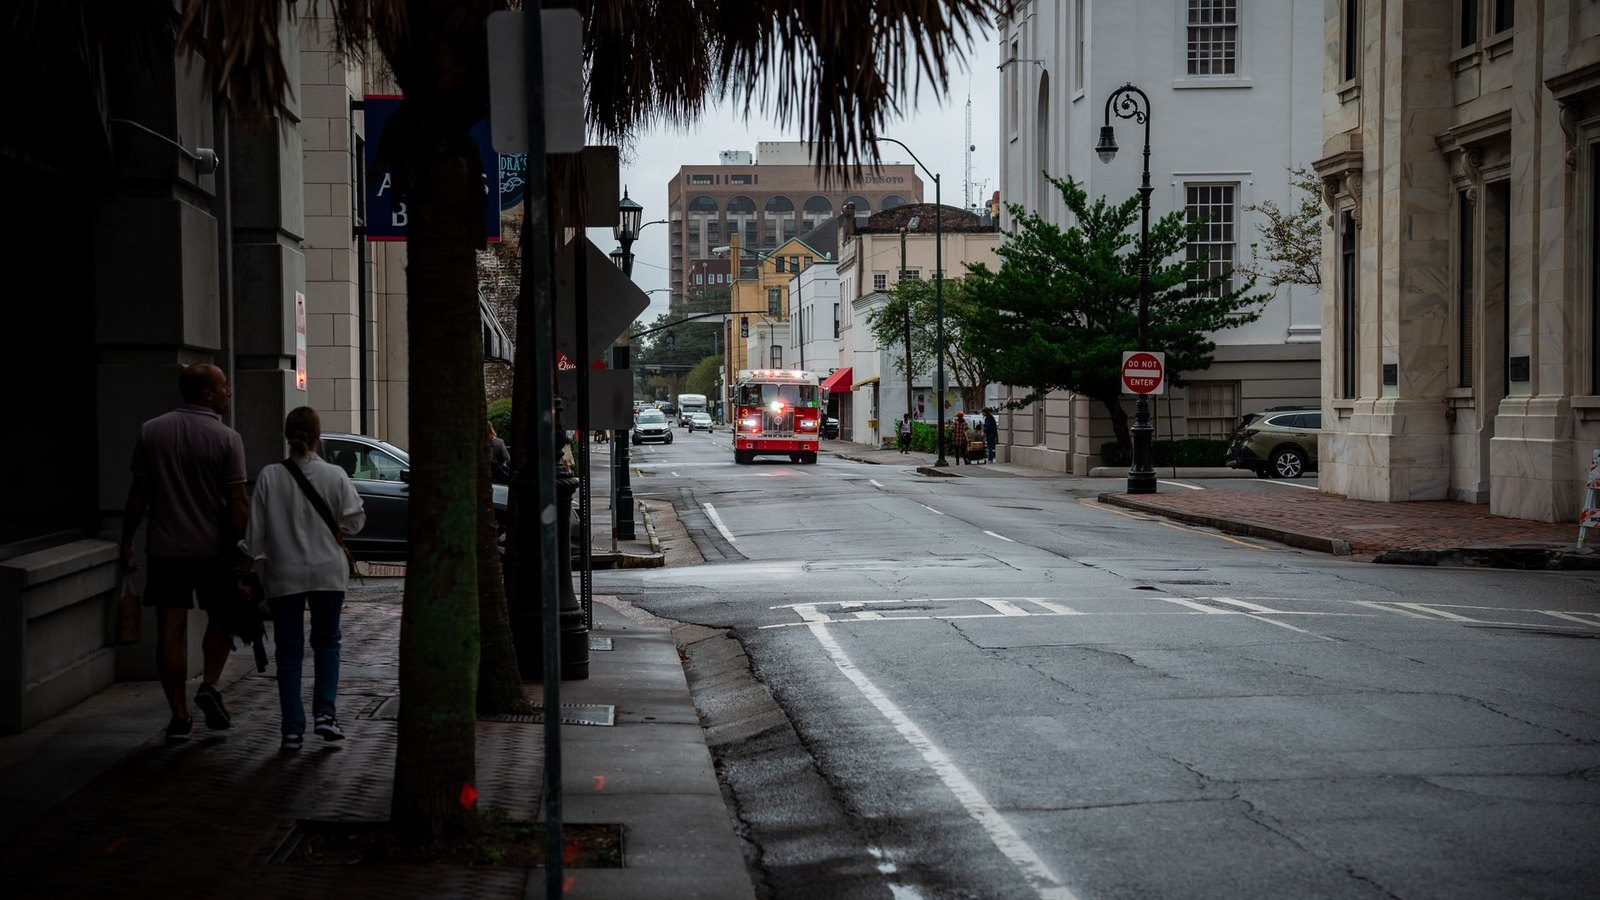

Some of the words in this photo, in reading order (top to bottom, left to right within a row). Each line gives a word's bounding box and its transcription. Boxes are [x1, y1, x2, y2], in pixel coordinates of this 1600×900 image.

[1128, 360, 1139, 368] DO
[1142, 360, 1157, 368] NOT
[1130, 378, 1154, 386] ENTER
[741, 408, 749, 417] 3
